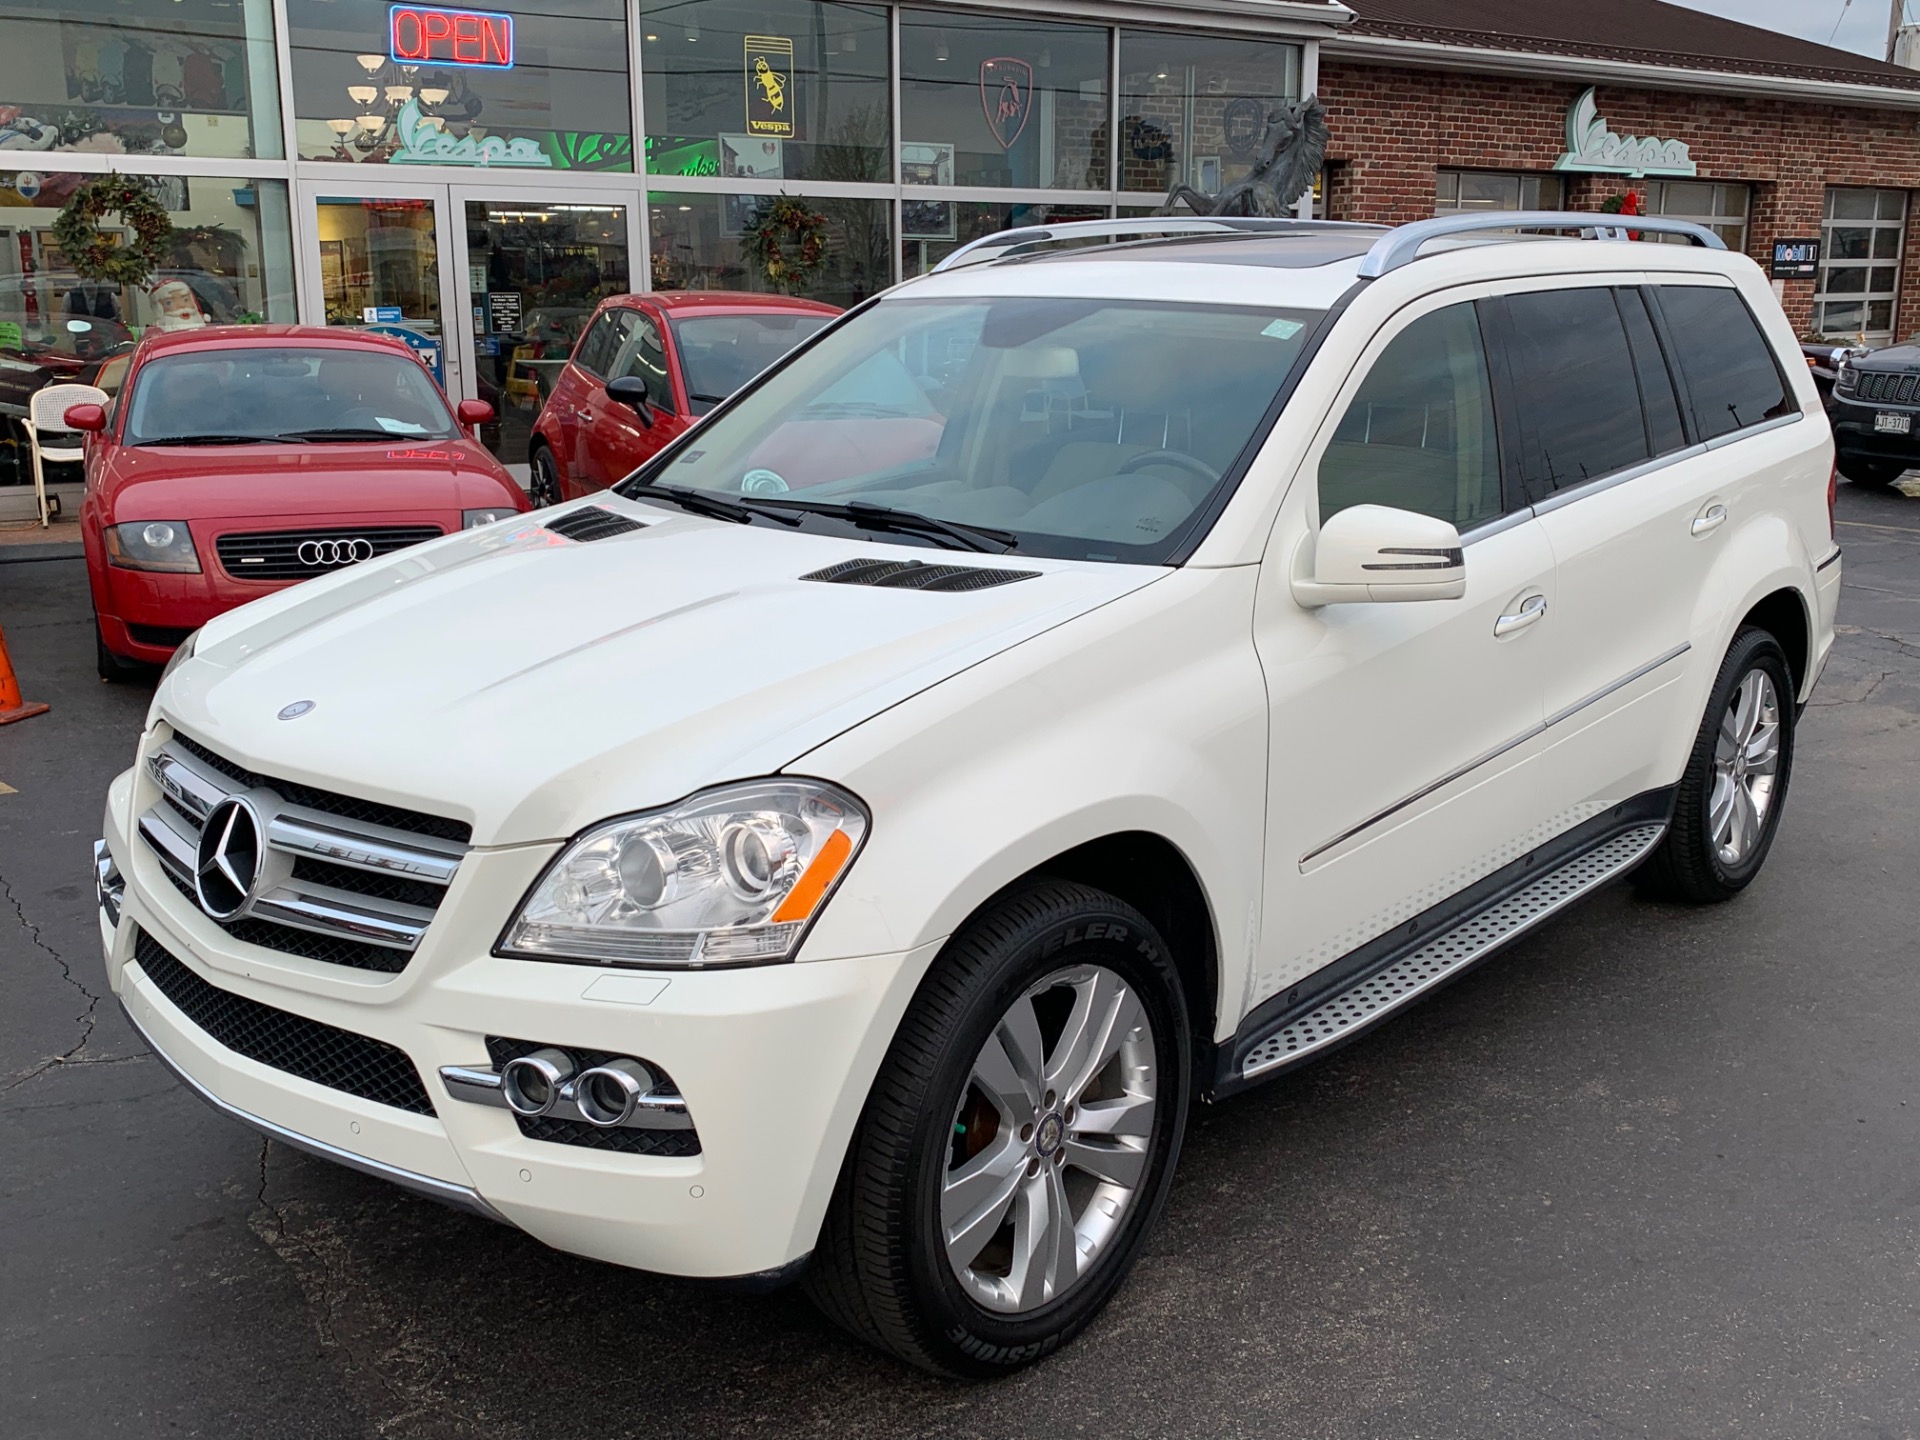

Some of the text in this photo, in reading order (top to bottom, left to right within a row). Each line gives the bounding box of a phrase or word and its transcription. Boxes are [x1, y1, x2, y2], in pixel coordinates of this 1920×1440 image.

[395, 11, 508, 64] OPEN
[391, 97, 552, 167] Vespa
[751, 121, 791, 132] Vespa
[1555, 86, 1696, 177] Vespa
[1775, 244, 1806, 261] Mobil
[1875, 416, 1910, 429] AJT-3710
